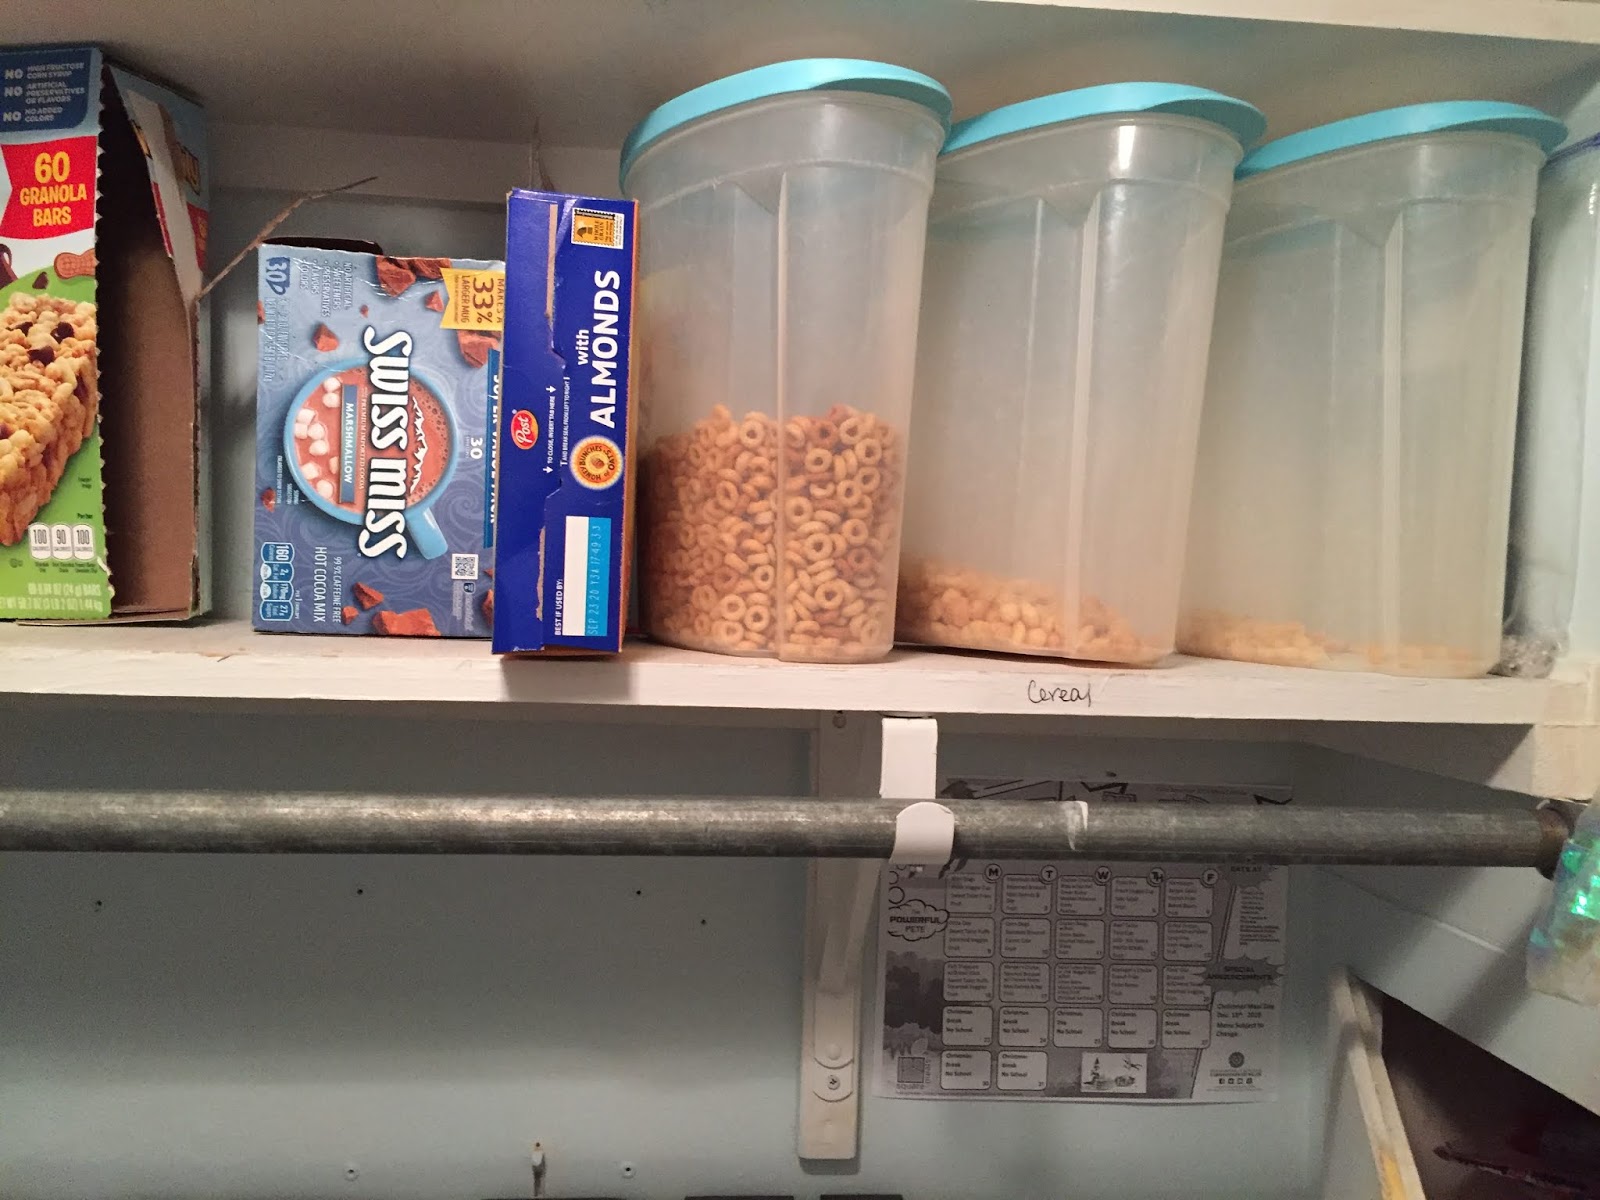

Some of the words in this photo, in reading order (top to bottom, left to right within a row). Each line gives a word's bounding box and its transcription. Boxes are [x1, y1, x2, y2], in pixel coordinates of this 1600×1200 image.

[5, 69, 23, 79] NO
[5, 86, 23, 97] NO
[26, 88, 85, 96] PRESERVATIVES
[3, 111, 21, 121] NO
[35, 152, 70, 184] 60
[20, 184, 87, 205] GRANOLA
[33, 207, 71, 226] BARS
[266, 261, 287, 282] 30
[344, 262, 352, 271] NO
[300, 264, 309, 290] COLORS
[321, 266, 330, 317] PRESERVATIVES
[334, 267, 342, 310] SWEETENERS
[344, 273, 352, 309] ARTIFICIAL
[462, 276, 470, 303] LARGER
[473, 278, 493, 323] 33%
[461, 306, 469, 322] MUG
[576, 330, 590, 366] with
[590, 270, 620, 428] ALMONDS
[364, 326, 412, 449] SWISS
[516, 416, 532, 443] Post
[344, 403, 354, 483] MARSHMALLOW
[470, 438, 482, 459] 30
[579, 446, 602, 465] BUNCHES
[605, 450, 615, 470] OATS
[580, 467, 601, 480] HONEY
[359, 459, 407, 558] MISS
[33, 530, 47, 544] 100
[56, 530, 66, 544] 90
[77, 530, 89, 544] 100
[276, 545, 289, 560] 160
[315, 547, 326, 566] HOT
[279, 583, 288, 599] 170mg
[314, 569, 326, 601] COCOA
[313, 603, 325, 622] MIX
[589, 604, 599, 615] 23
[588, 618, 598, 634] SEP
[1028, 680, 1091, 707] Cereal
[1045, 870, 1053, 878] T
[1152, 872, 1164, 882] TH
